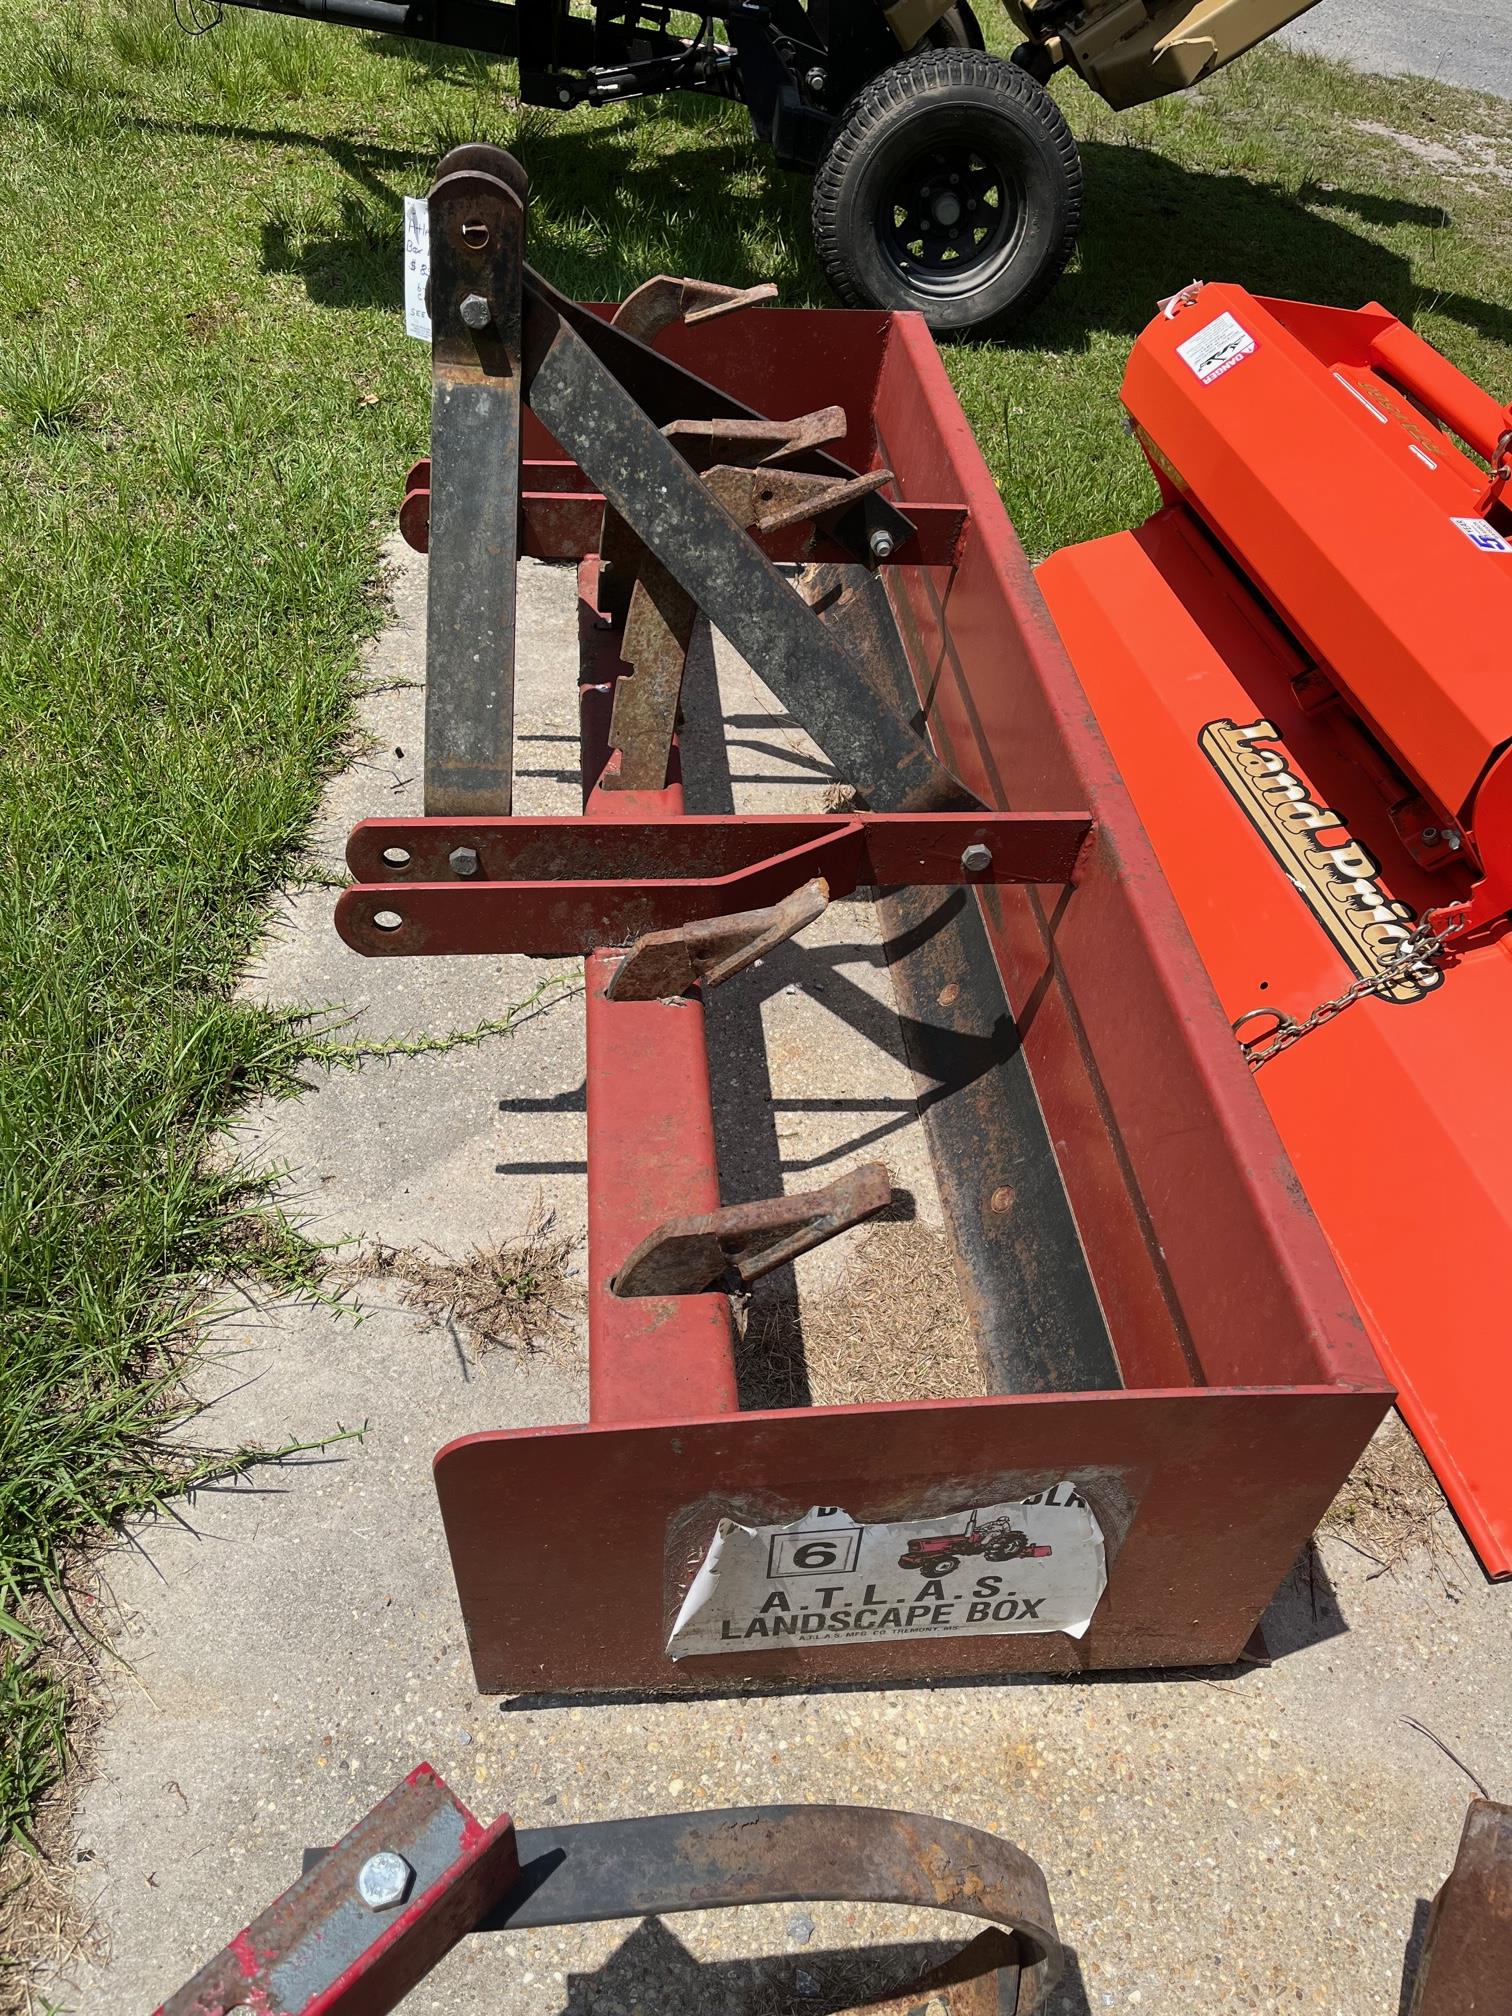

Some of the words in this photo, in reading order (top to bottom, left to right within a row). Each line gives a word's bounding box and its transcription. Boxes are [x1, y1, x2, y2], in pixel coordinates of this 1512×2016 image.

[1202, 352, 1245, 385] DANGER
[1217, 719, 1346, 836] Land
[792, 1541, 838, 1569] 6
[759, 1575, 1017, 1614] A.T.L.A.S.
[720, 1603, 955, 1641] LANDSCAPE
[965, 1598, 1047, 1623] BOX
